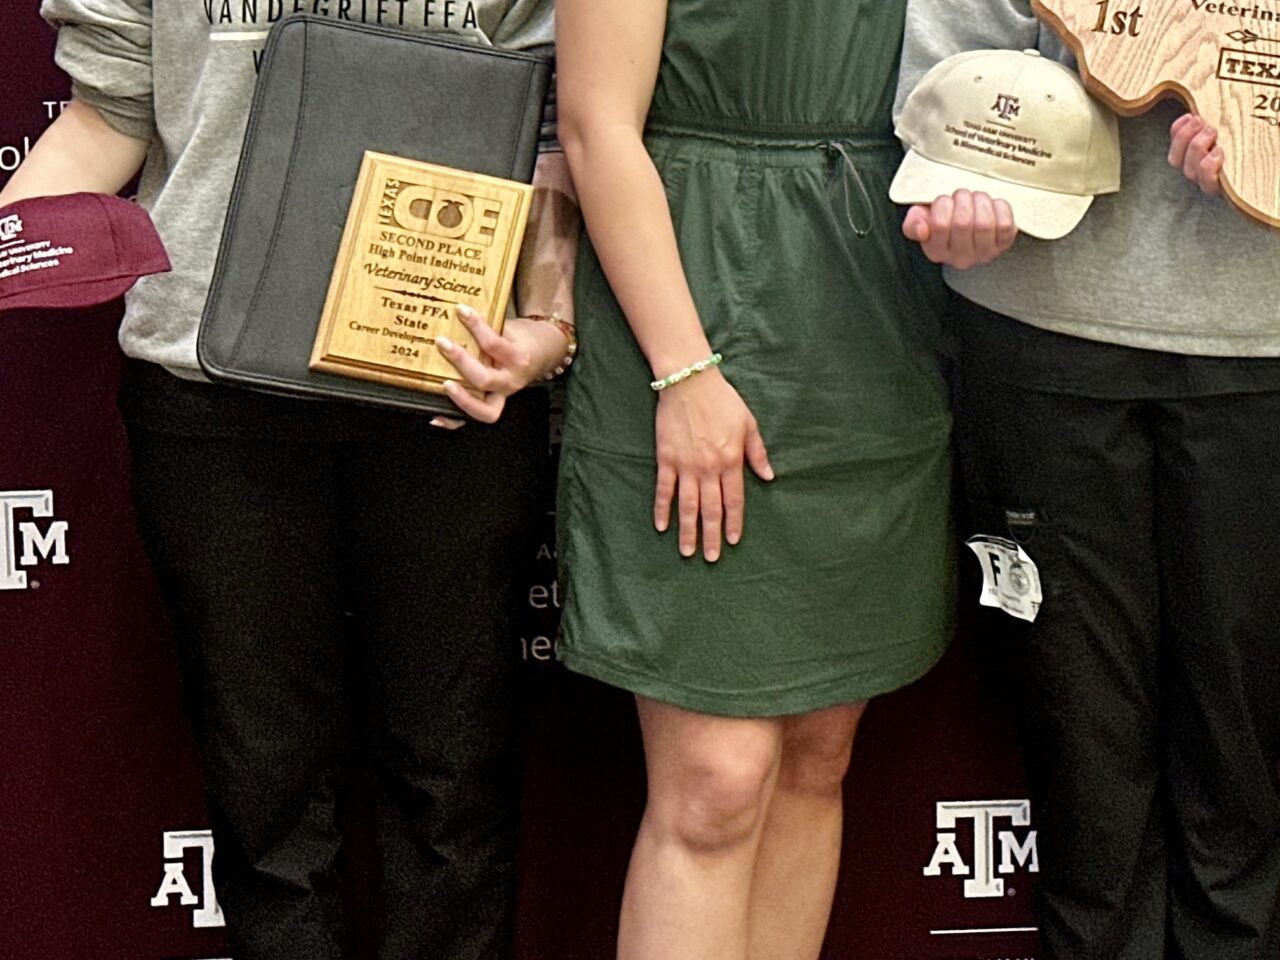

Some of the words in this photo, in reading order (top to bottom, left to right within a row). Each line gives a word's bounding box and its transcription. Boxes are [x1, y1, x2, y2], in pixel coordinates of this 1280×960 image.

[945, 124, 968, 138] School
[380, 230, 435, 251] SECOND
[437, 242, 483, 261] PLACE
[368, 243, 396, 259] High
[398, 249, 429, 265] Point
[429, 255, 487, 277] Individual
[363, 262, 435, 291] Veterinary
[433, 276, 483, 297] Science
[380, 296, 418, 314] Texas
[421, 304, 450, 321] FFA
[348, 320, 381, 335] Career
[393, 314, 429, 331] State
[389, 344, 420, 359] 2024
[988, 551, 1001, 587] F
